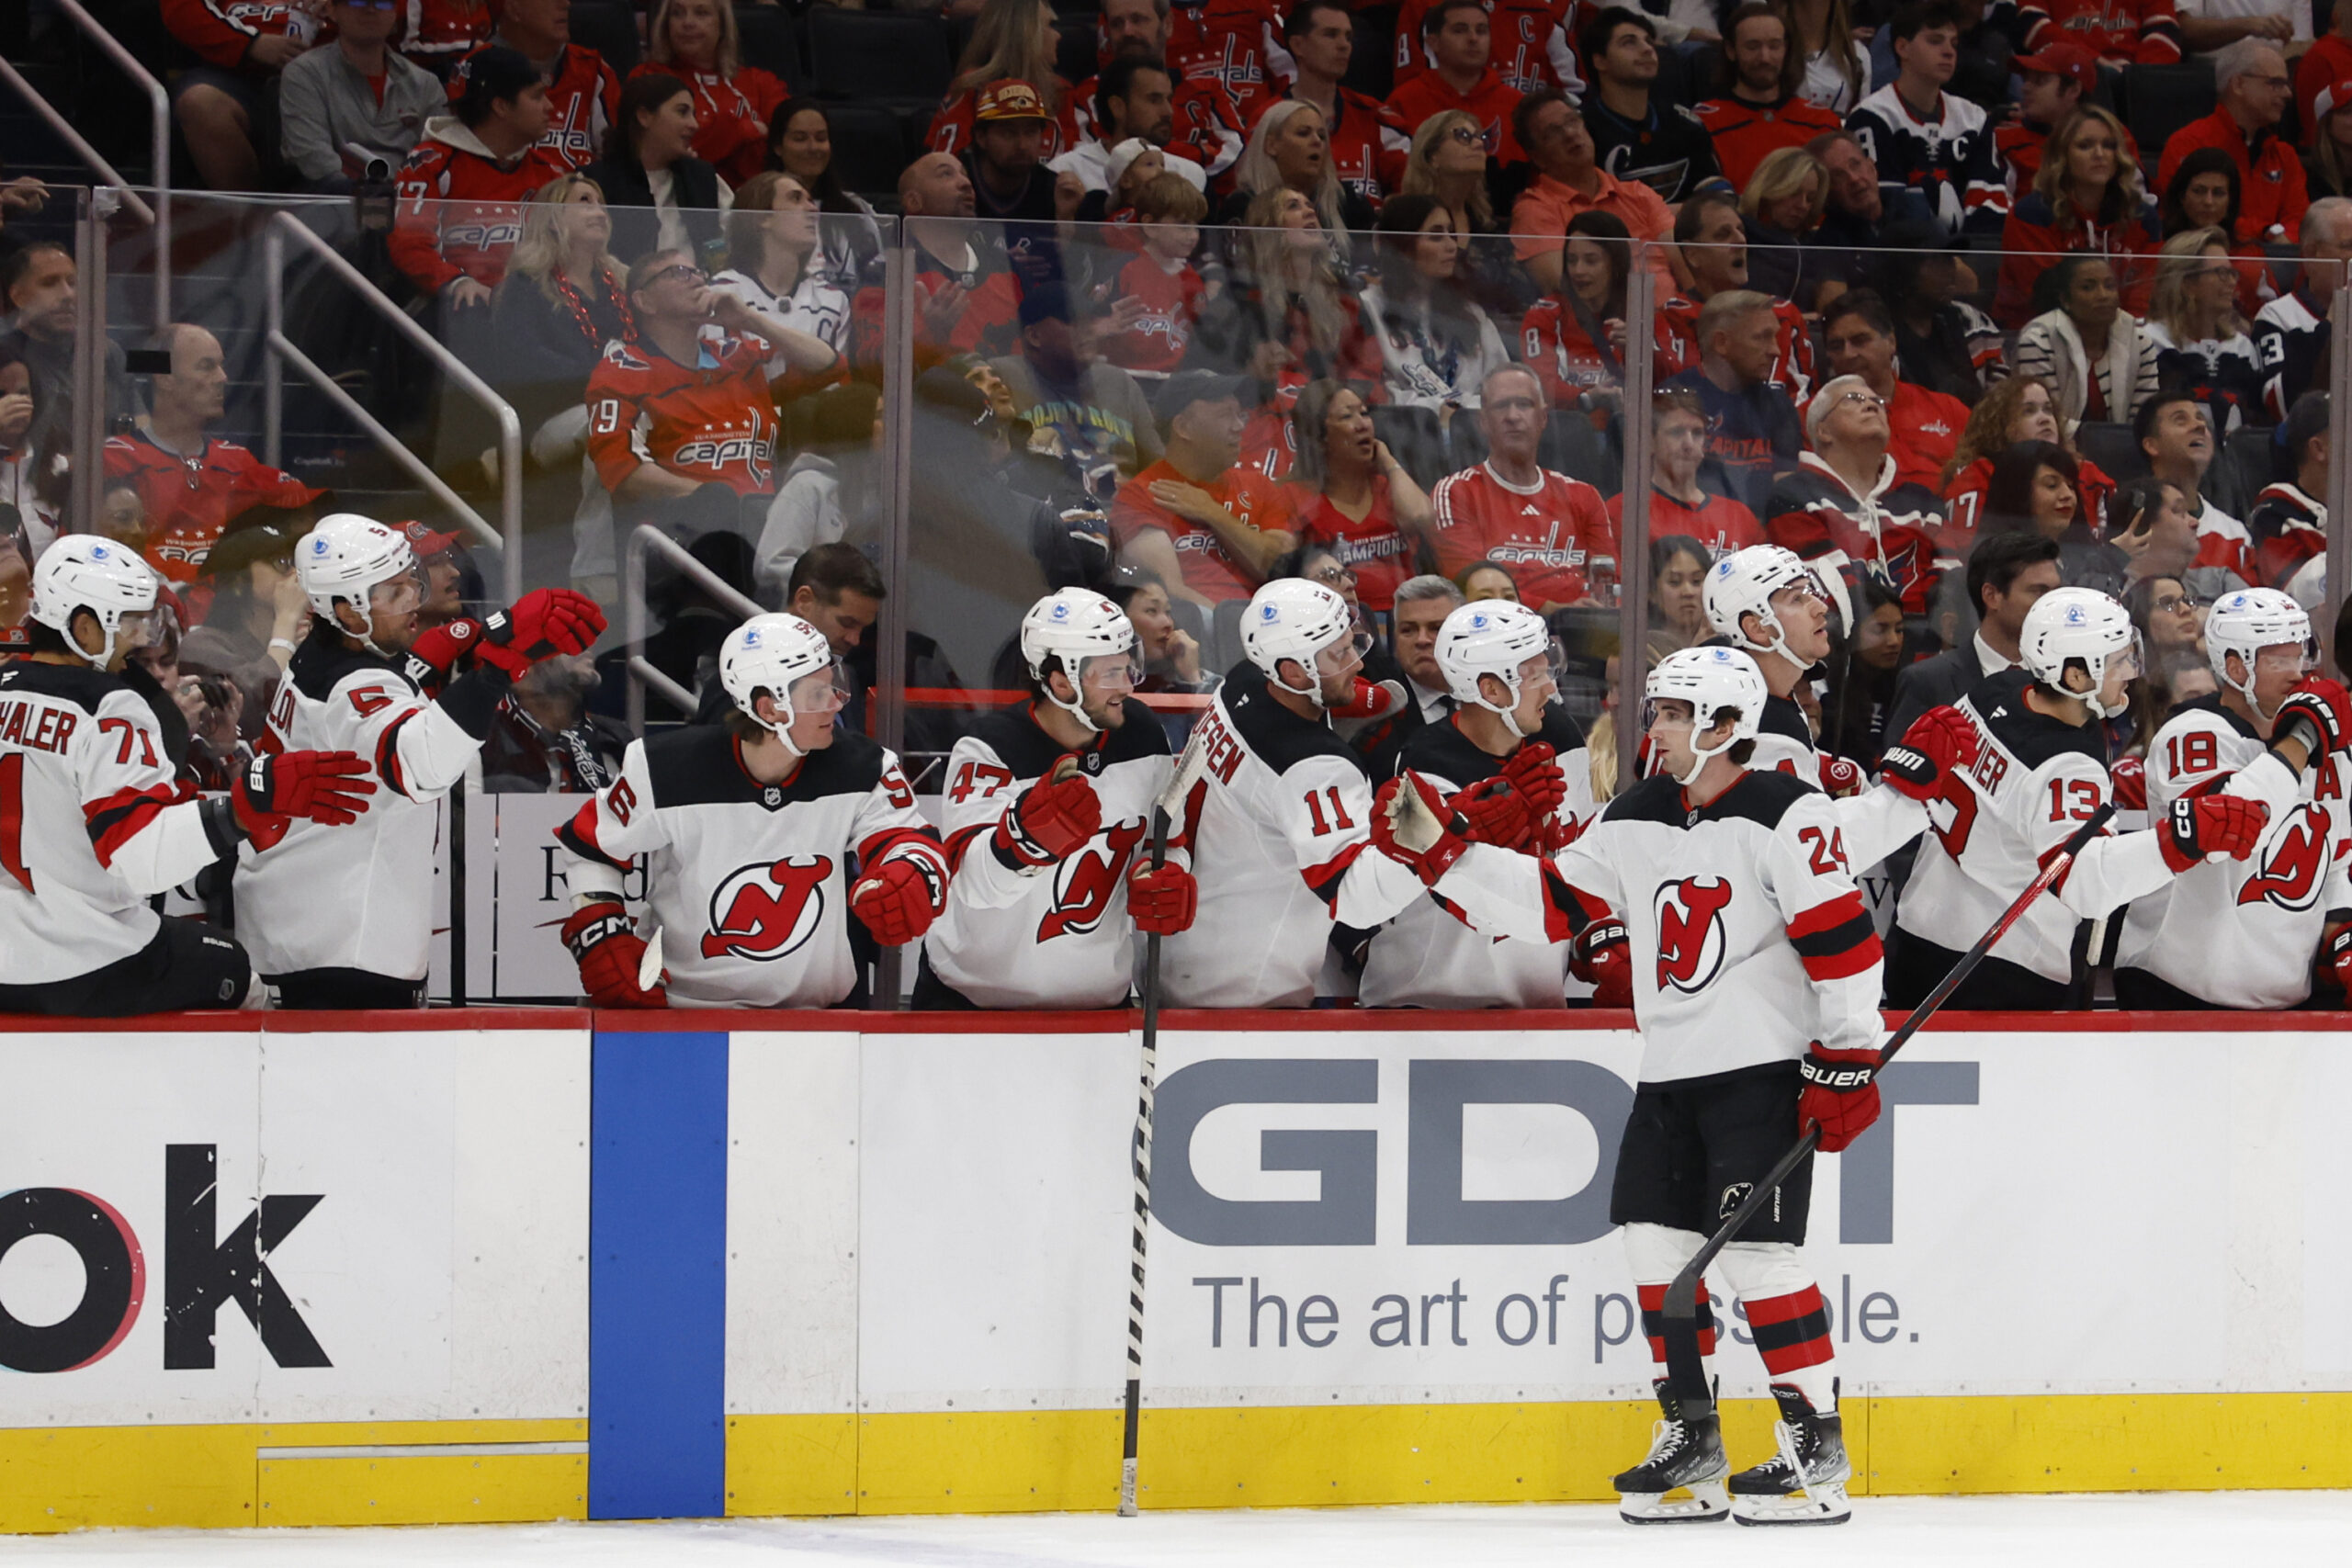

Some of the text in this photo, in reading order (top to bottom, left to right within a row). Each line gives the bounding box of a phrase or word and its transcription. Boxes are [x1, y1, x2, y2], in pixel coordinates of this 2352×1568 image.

[1951, 135, 1969, 163] C
[1486, 520, 1588, 568] capitals
[347, 685, 395, 719] 5
[98, 716, 161, 769] 71
[2165, 730, 2219, 781] 18
[879, 764, 915, 810] 5
[947, 761, 1014, 805] 47
[2313, 740, 2344, 802] A
[606, 774, 638, 828] 6
[1303, 785, 1355, 838] 11
[2049, 777, 2101, 824] 13
[1796, 825, 1851, 877] 24
[1131, 1058, 1980, 1247] GDT
[1192, 1276, 1340, 1348] The
[1369, 1277, 1468, 1348] art
[1495, 1273, 1569, 1348] of
